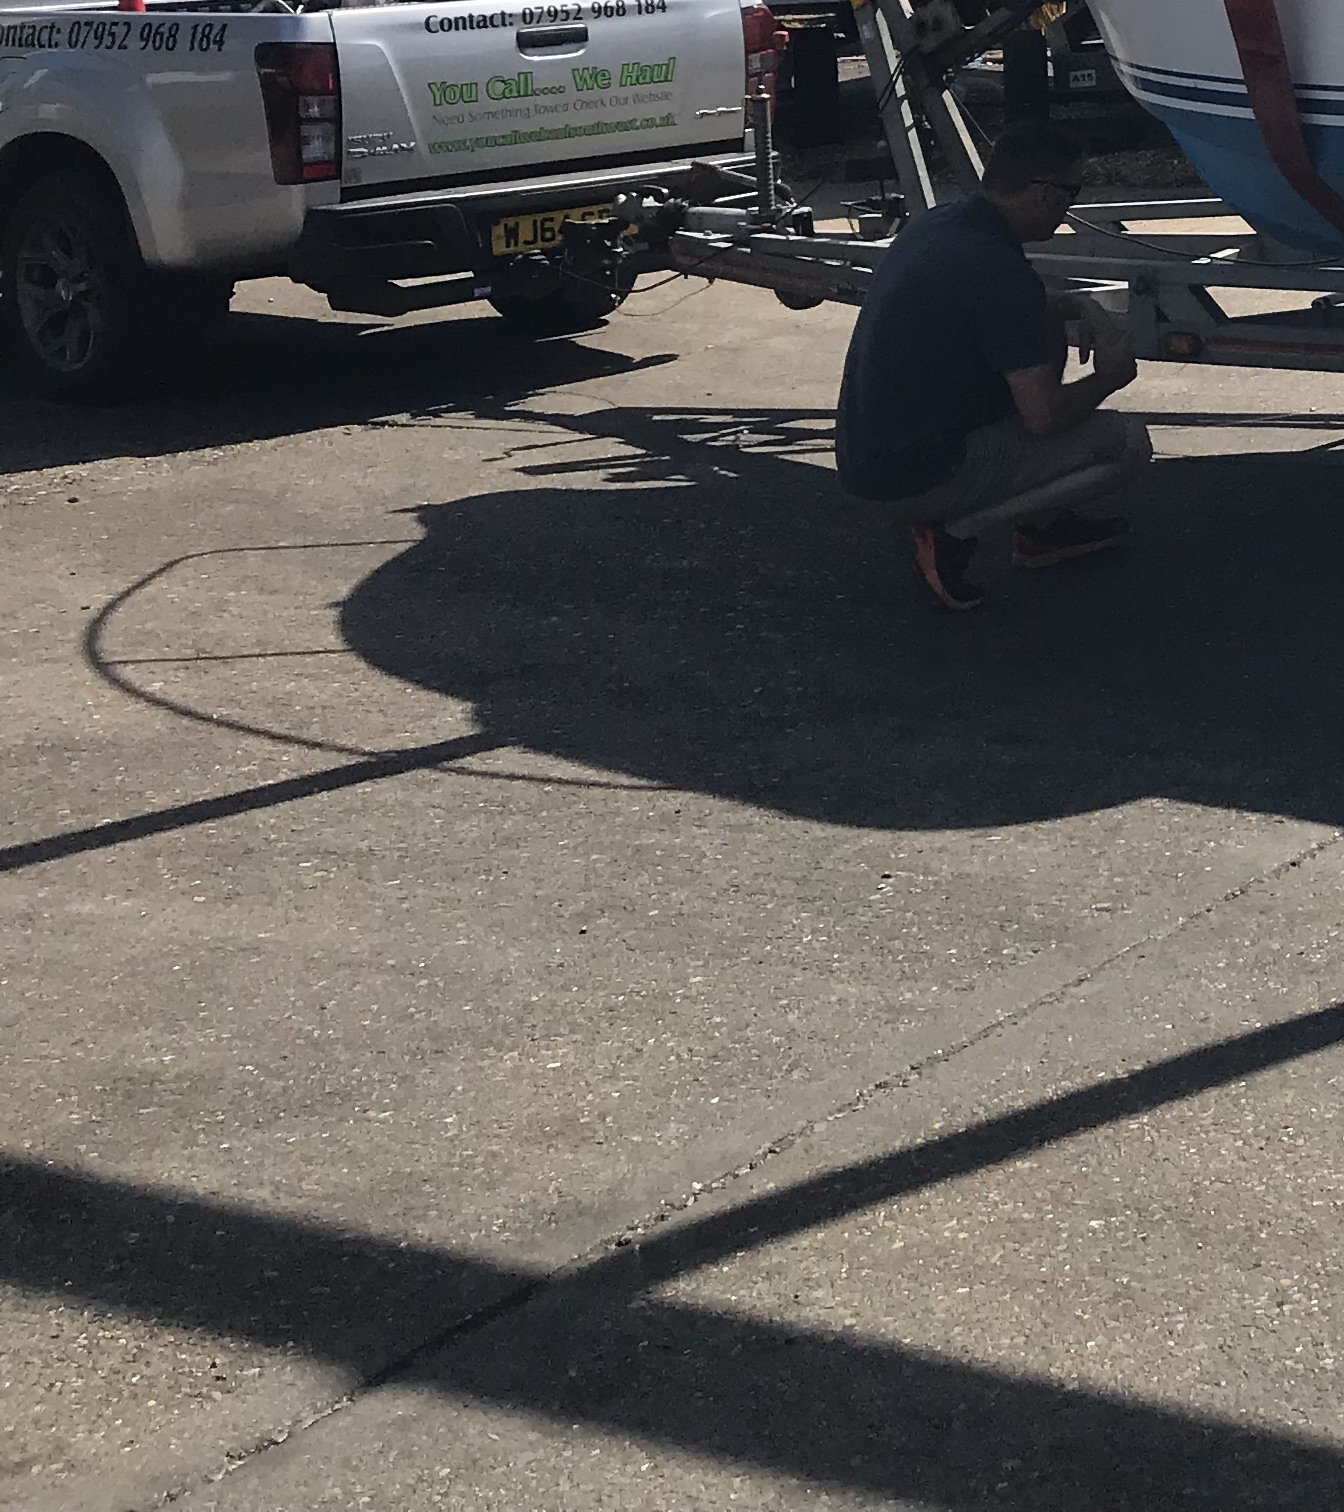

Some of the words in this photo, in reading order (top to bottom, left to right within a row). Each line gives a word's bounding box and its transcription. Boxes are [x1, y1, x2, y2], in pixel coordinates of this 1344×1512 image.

[424, 10, 514, 33] Contact:
[522, 3, 583, 25] 07952
[591, 0, 626, 19] 968
[67, 21, 131, 50] 07952
[139, 22, 179, 51] 968
[189, 23, 228, 52] 184
[428, 81, 478, 106] You
[571, 67, 611, 92] We
[619, 57, 676, 87] Haul
[432, 114, 465, 126] Need
[468, 106, 530, 124] Something
[609, 94, 629, 107] Our
[632, 90, 672, 104] Website
